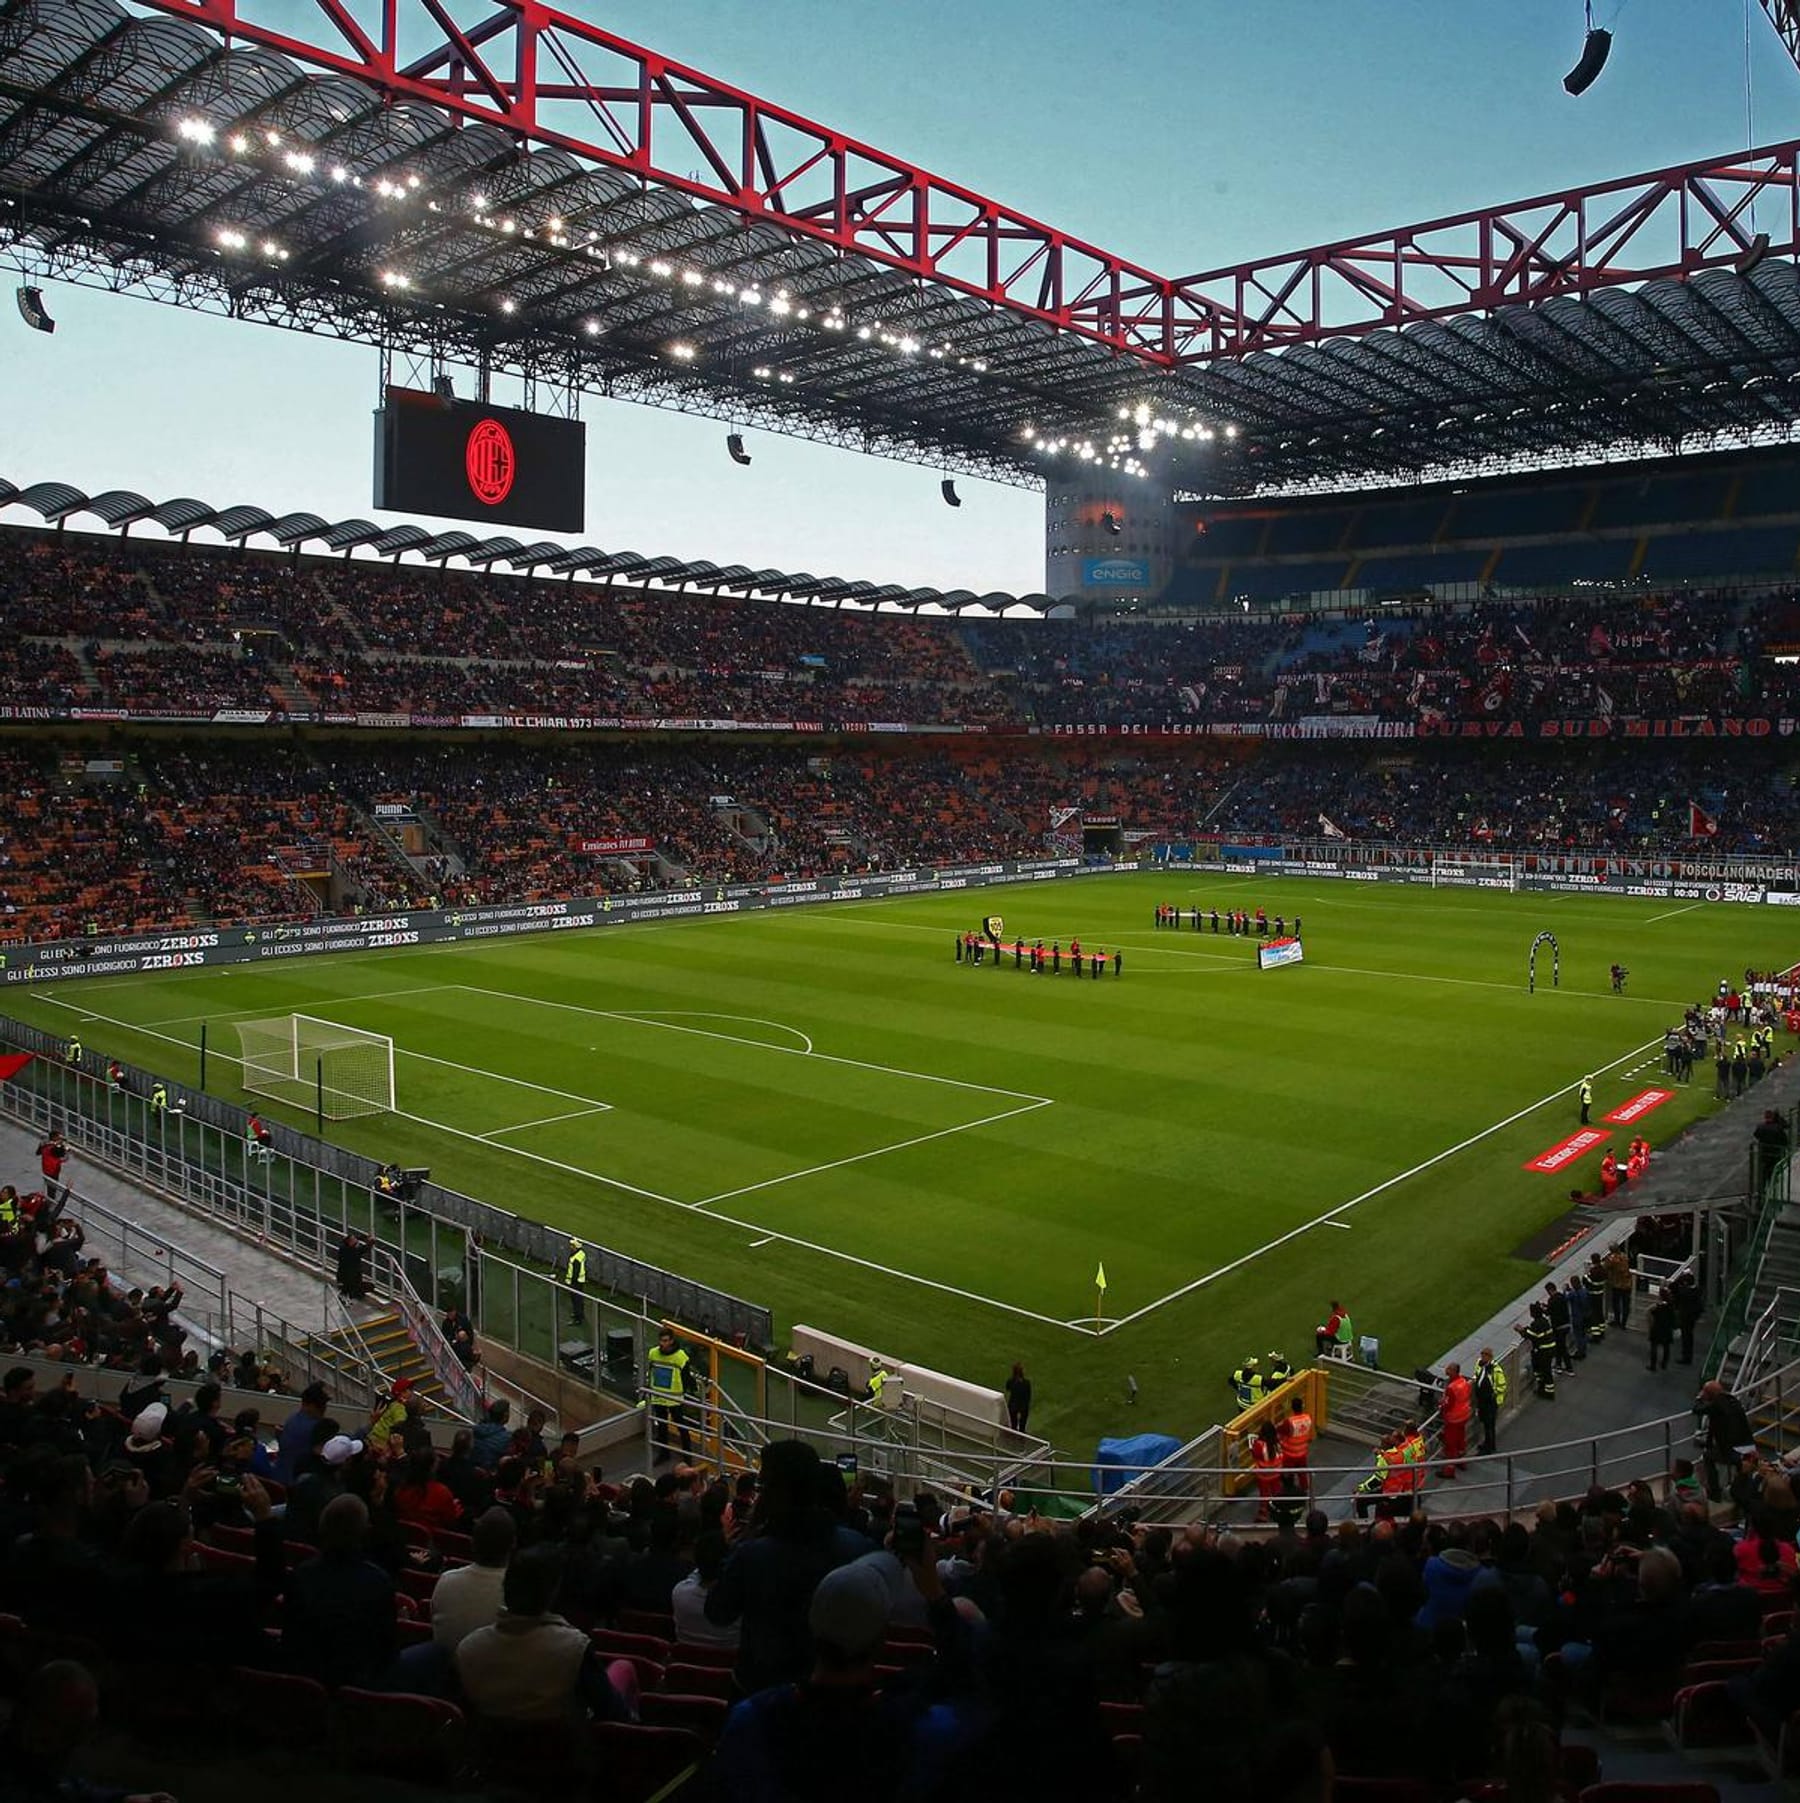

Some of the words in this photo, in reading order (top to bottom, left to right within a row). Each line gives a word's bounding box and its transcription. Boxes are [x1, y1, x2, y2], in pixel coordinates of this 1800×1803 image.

[15, 706, 50, 718] LATINA
[1416, 720, 1525, 737] CURVA
[1540, 720, 1610, 737] SUD
[1624, 718, 1771, 737] MILANO
[360, 917, 409, 933] ZEROXS
[160, 933, 219, 951] ZEROXS
[368, 930, 420, 948] ZEROXS
[61, 962, 86, 976] SONO
[87, 958, 137, 973] FUORIGIOCO
[141, 951, 205, 969] ZEROXS
